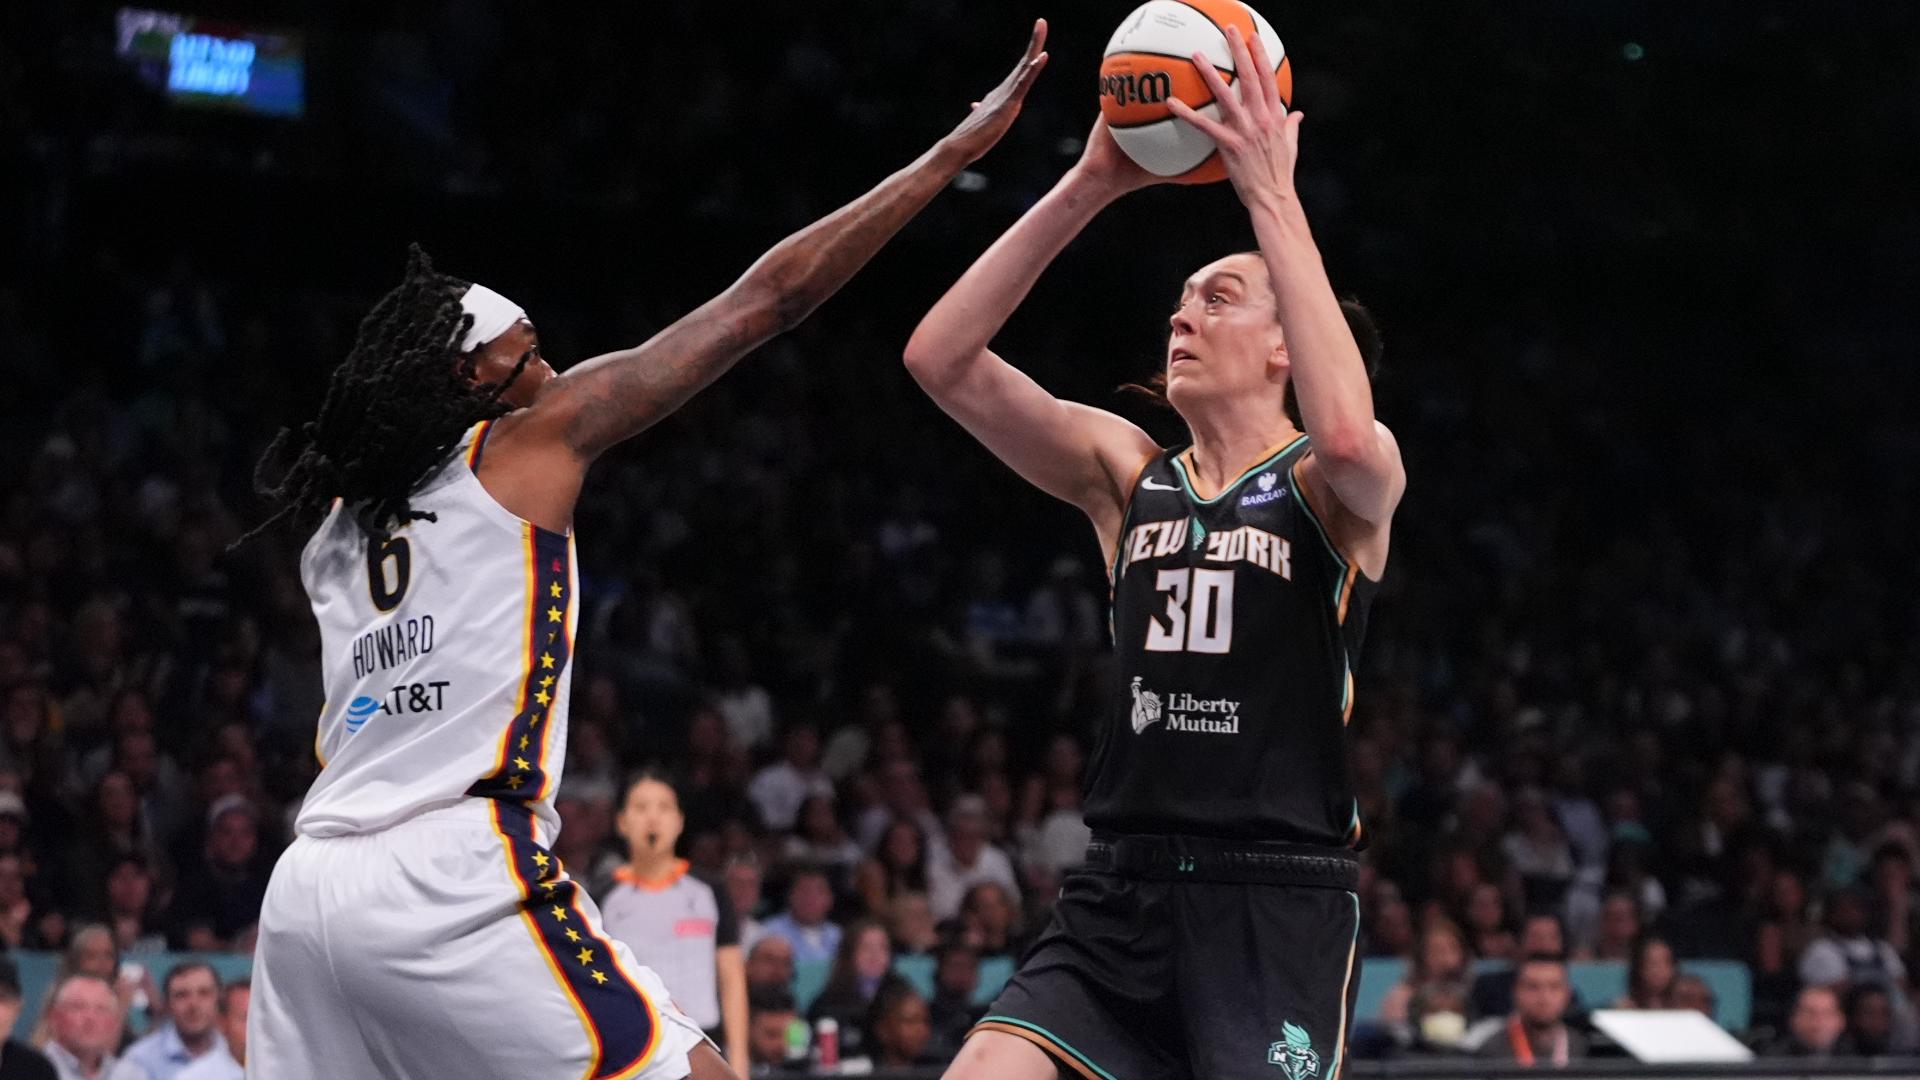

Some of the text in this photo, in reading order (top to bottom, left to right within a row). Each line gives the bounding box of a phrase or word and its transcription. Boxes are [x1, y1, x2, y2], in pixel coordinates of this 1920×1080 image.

[367, 522, 411, 612] 6
[1121, 516, 1292, 582] NEW YORK
[1144, 567, 1235, 654] 30
[353, 614, 434, 680] HOWARD
[1165, 713, 1240, 734] Mutual
[1167, 693, 1240, 720] Liberty
